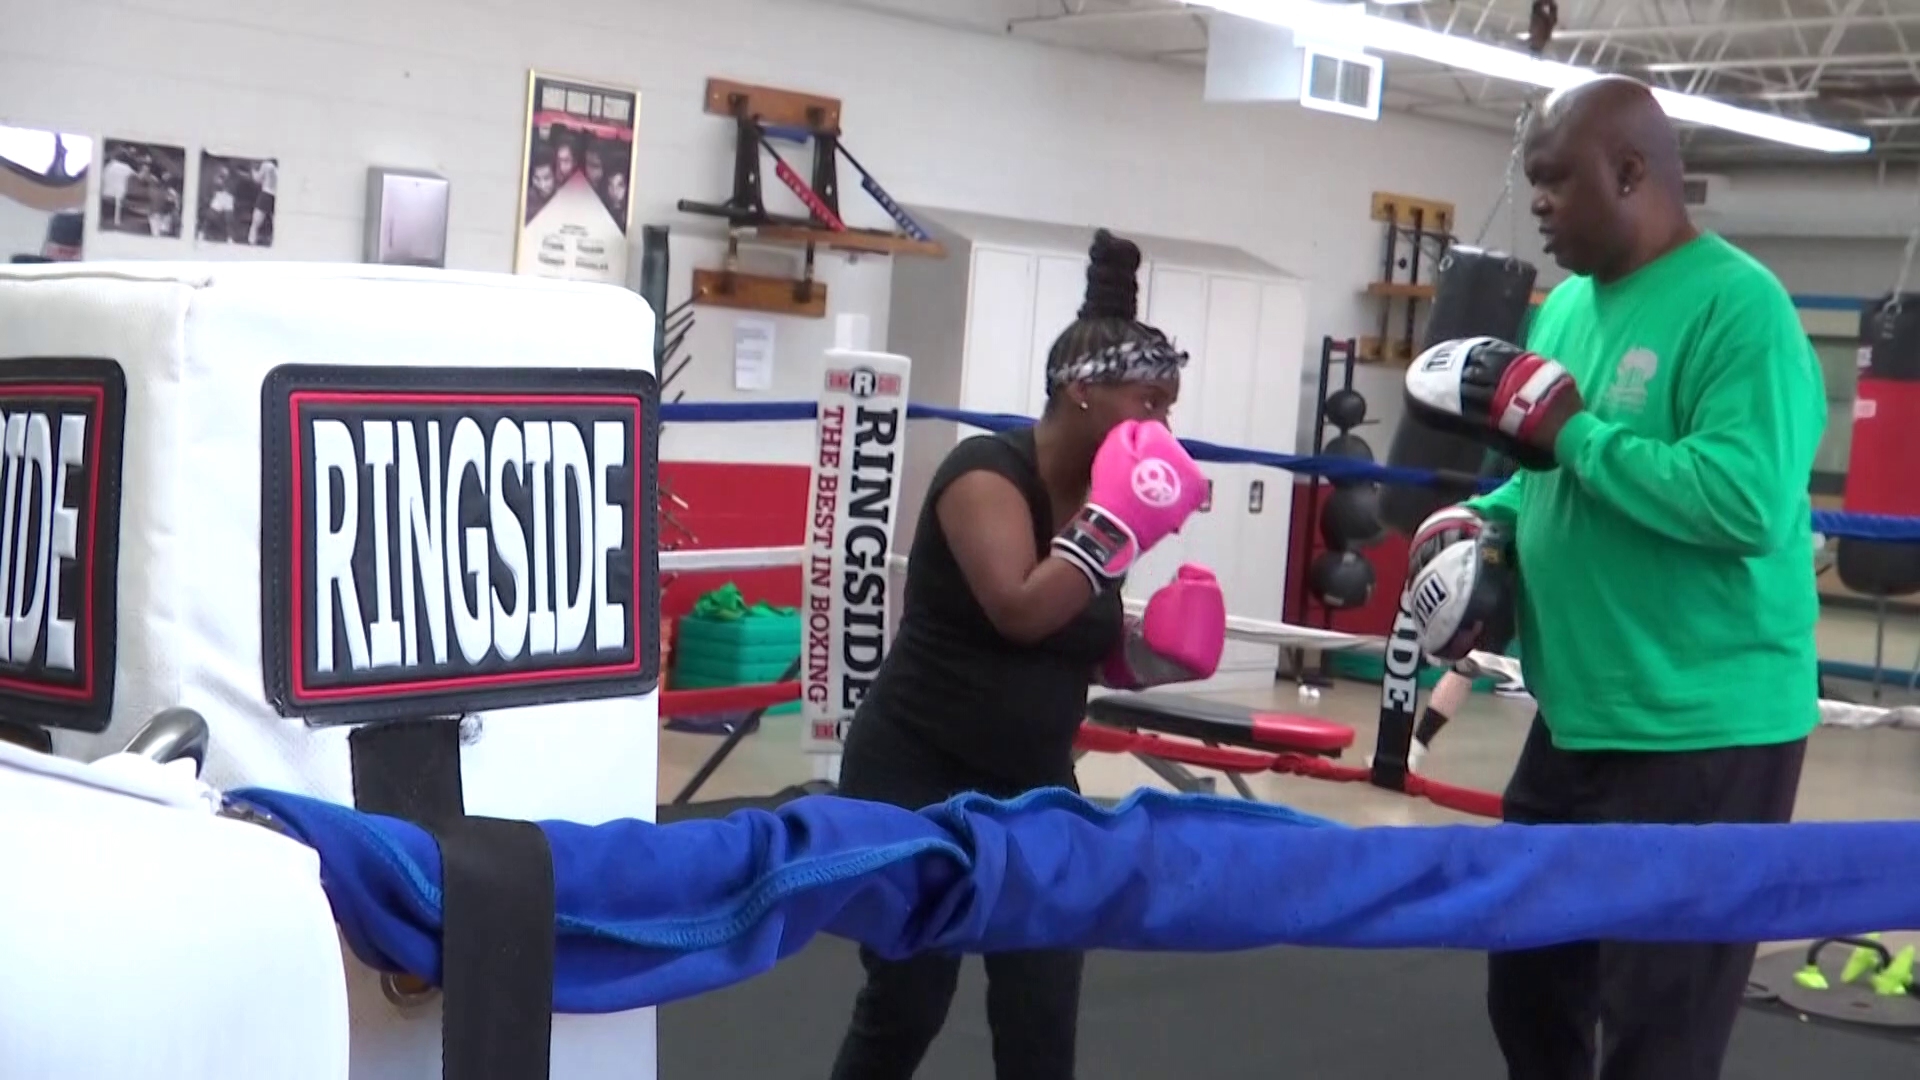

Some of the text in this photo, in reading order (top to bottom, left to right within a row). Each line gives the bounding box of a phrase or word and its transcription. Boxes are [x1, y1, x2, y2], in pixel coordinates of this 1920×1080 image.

[822, 405, 845, 469] THE
[0, 411, 87, 672] IDE
[311, 416, 626, 673] RINGSIDE
[813, 473, 839, 549] BEST
[842, 405, 899, 711] RINGSIDE
[811, 555, 832, 588] IN
[807, 595, 830, 704] BOXING
